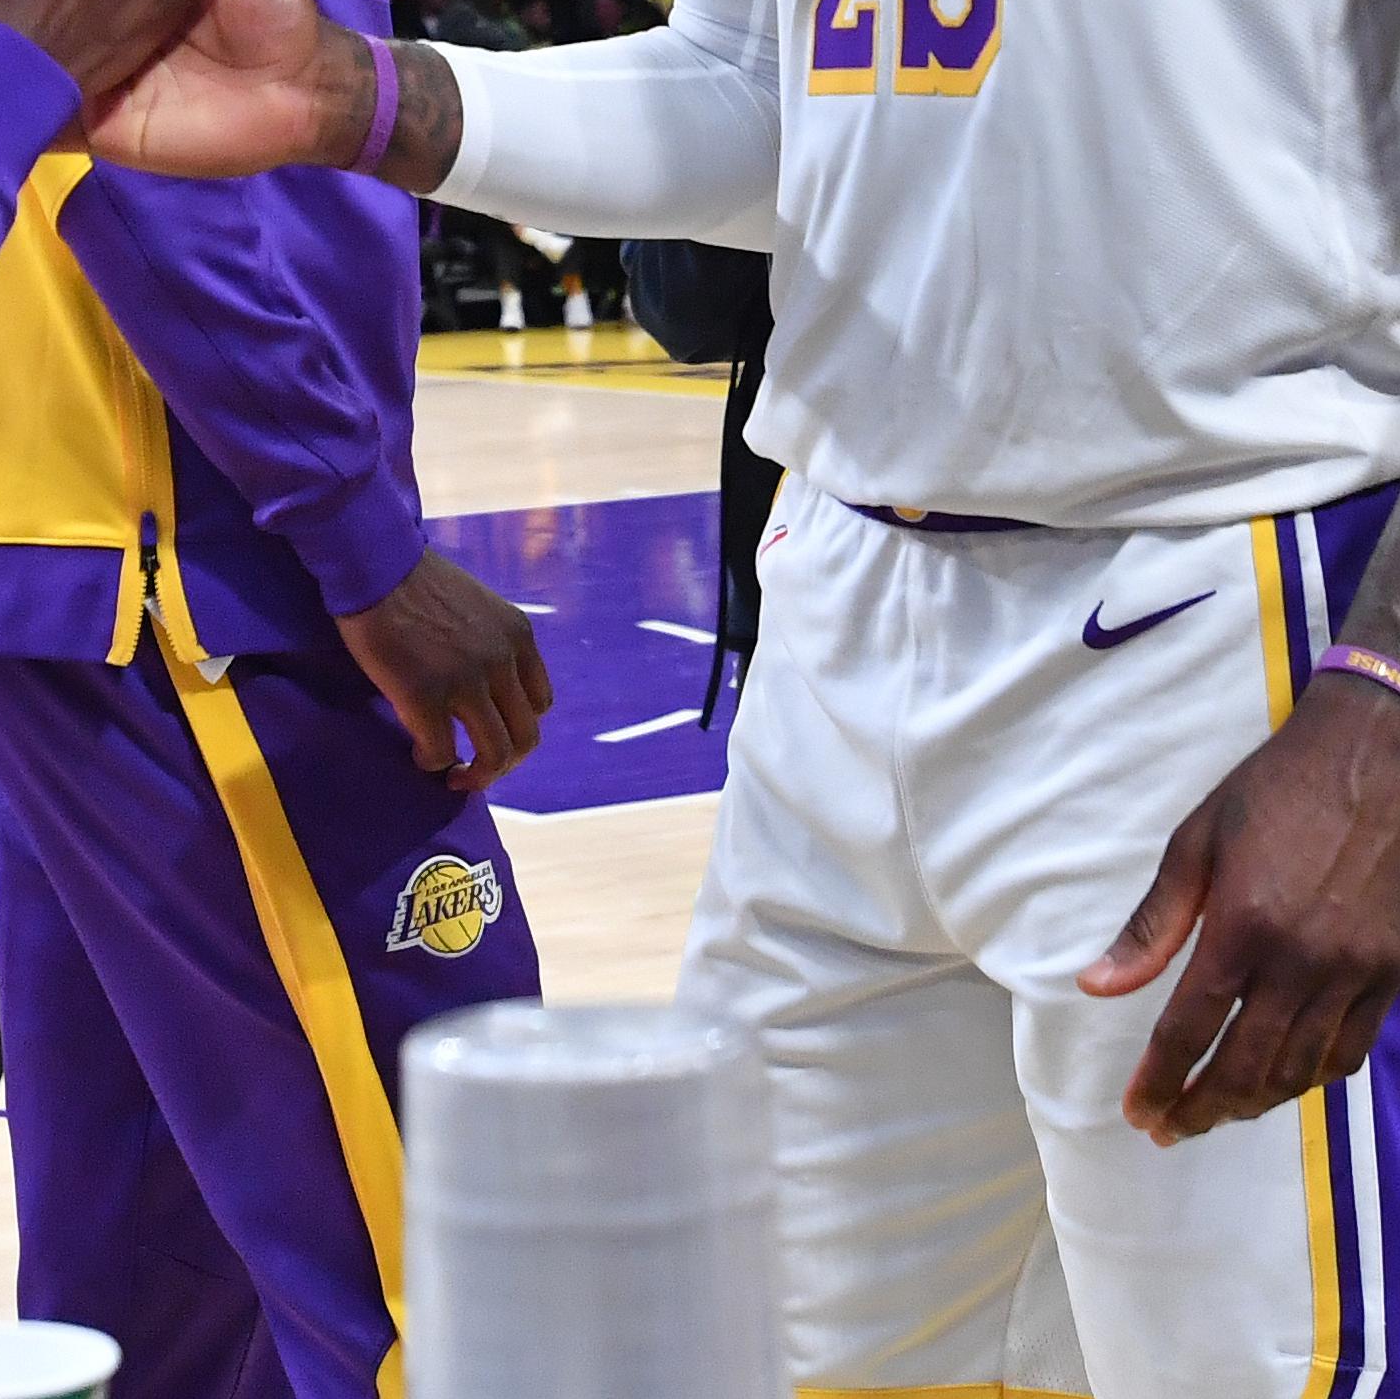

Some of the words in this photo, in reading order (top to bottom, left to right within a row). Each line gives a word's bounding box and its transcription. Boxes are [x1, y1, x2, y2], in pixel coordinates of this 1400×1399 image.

[426, 882, 448, 897] LOS
[449, 865, 492, 889] ANGELES
[391, 878, 500, 944] LAKERS
